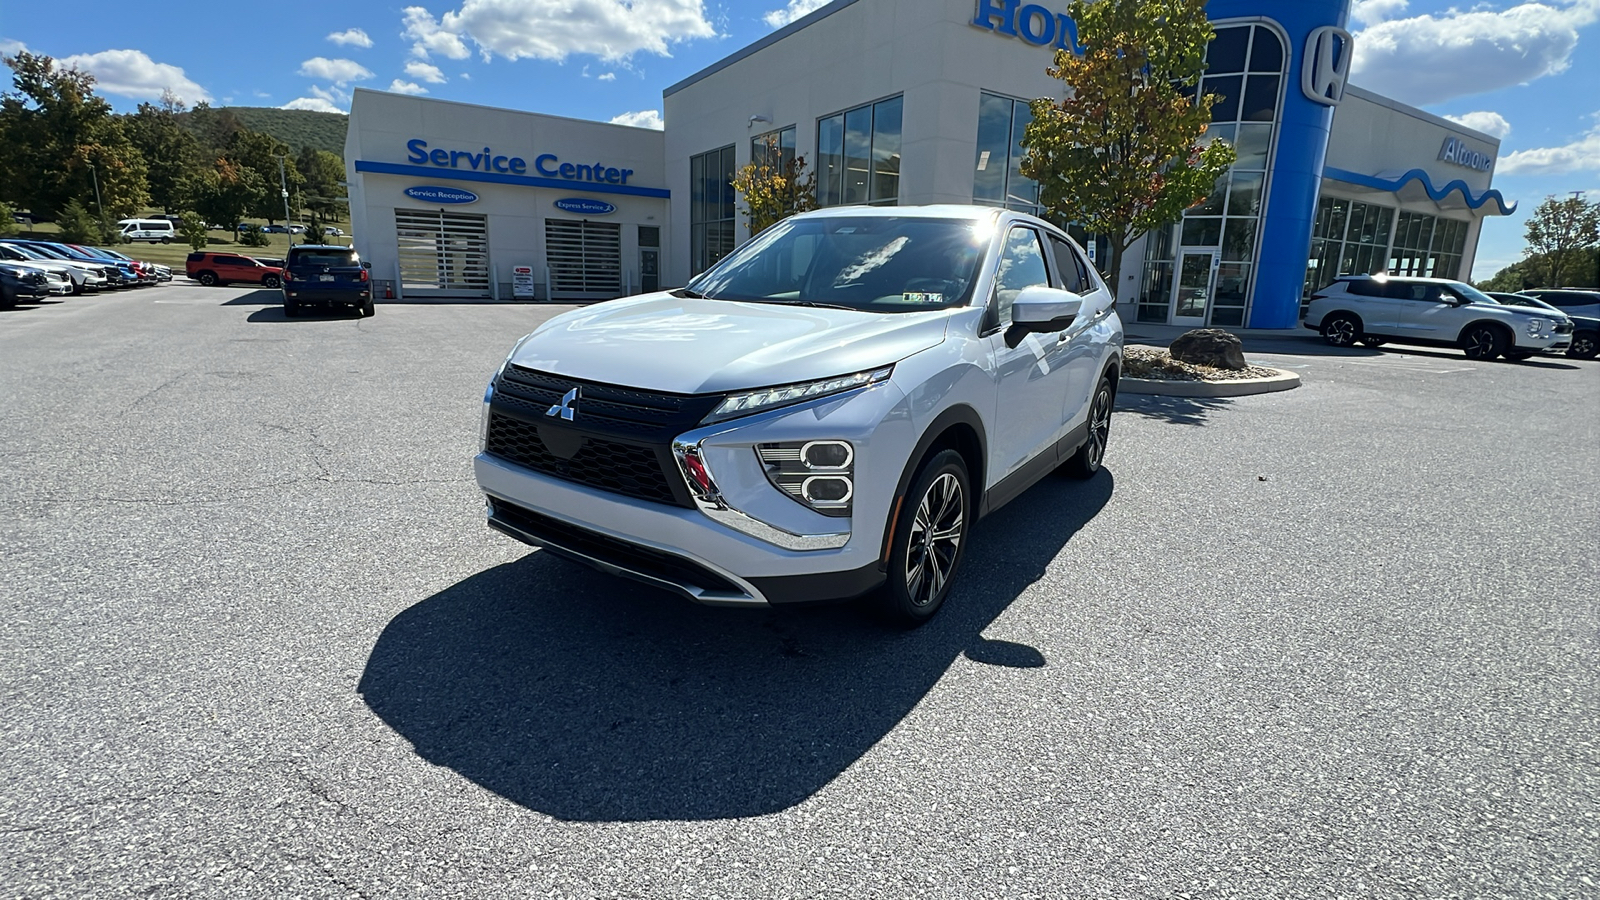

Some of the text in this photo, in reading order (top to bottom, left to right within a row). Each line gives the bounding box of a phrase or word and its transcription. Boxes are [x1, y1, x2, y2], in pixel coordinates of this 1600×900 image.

[407, 139, 634, 184] Service Center
[1443, 137, 1491, 172] Altoona
[408, 189, 474, 200] Service Reception
[557, 201, 604, 210] Express Service
